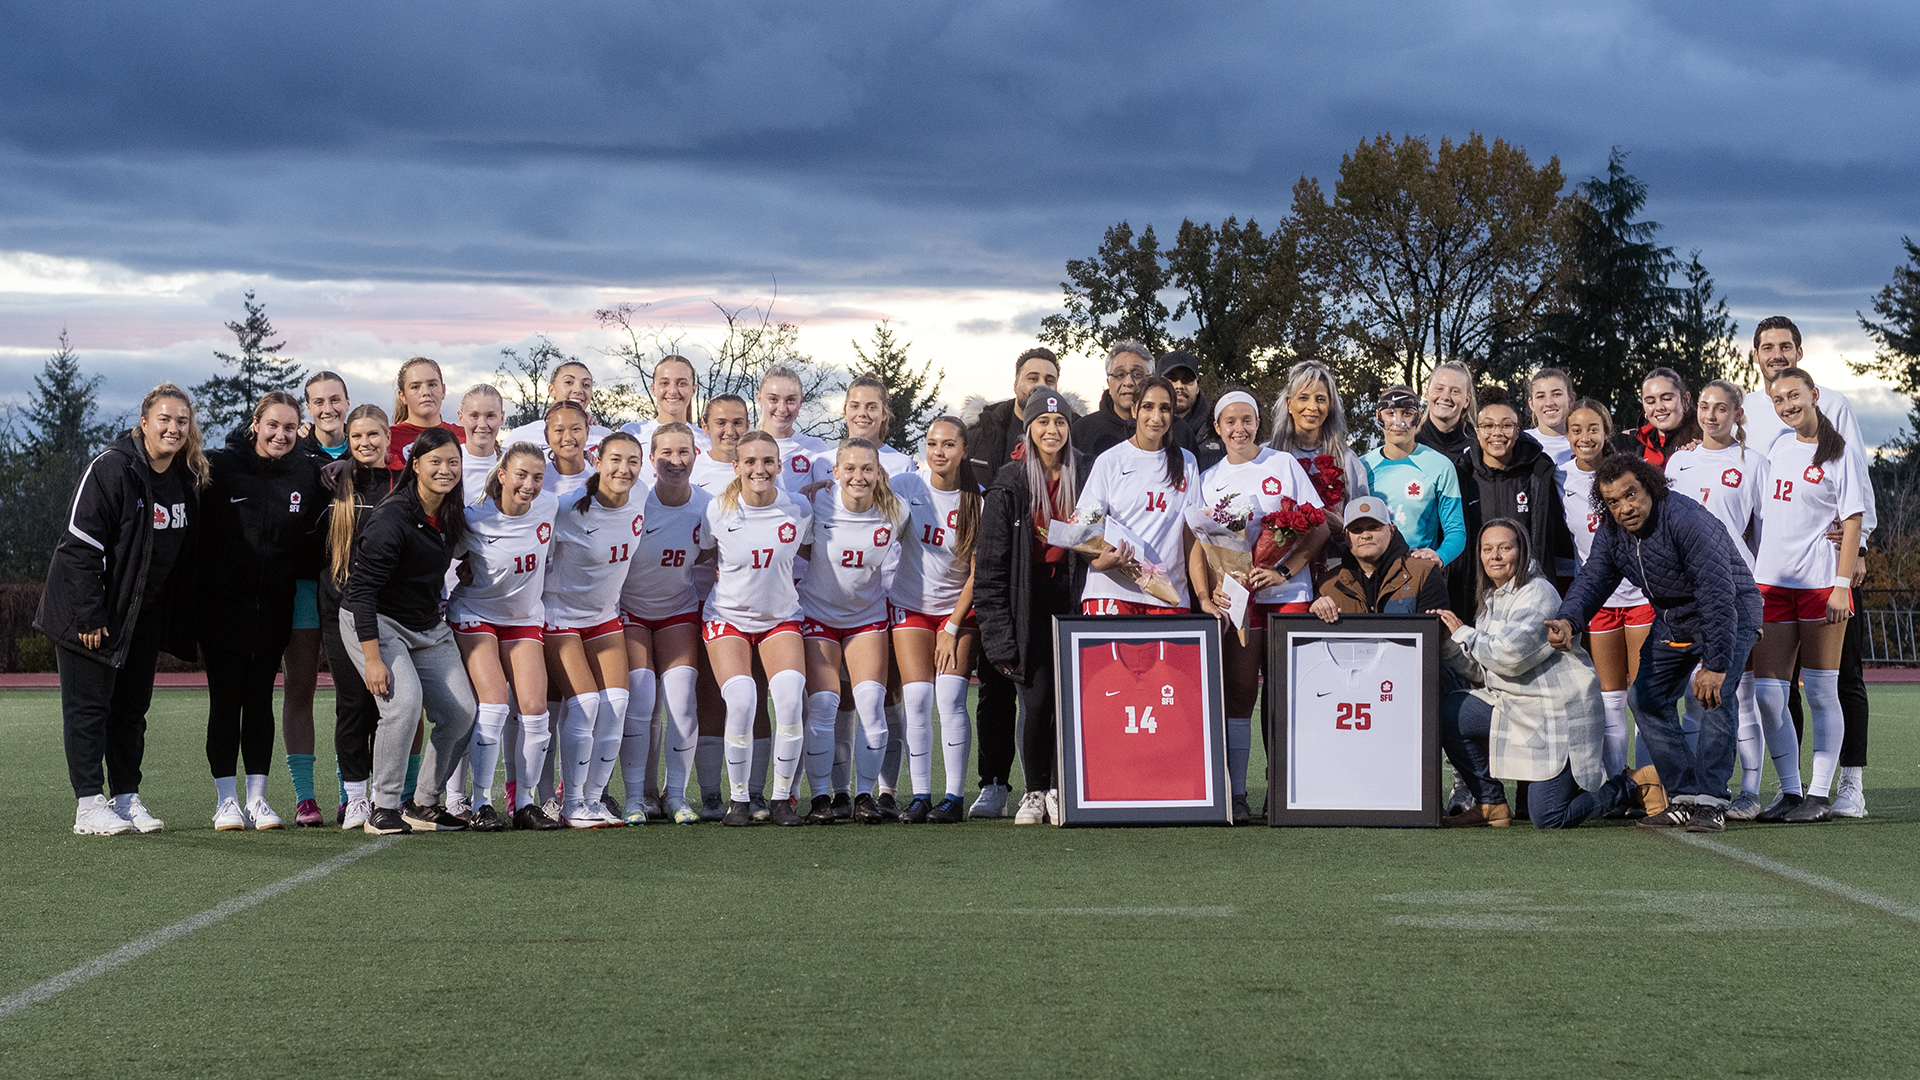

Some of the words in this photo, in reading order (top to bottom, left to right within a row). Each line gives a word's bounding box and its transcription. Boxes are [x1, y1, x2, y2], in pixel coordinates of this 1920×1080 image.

[1700, 487, 1711, 506] 7
[1773, 479, 1793, 502] 12
[1145, 491, 1167, 513] 14
[171, 503, 188, 529] SF
[1587, 513, 1602, 533] 2
[920, 524, 945, 547] 16
[513, 553, 537, 575] 18
[608, 543, 629, 564] 11
[660, 549, 686, 567] 26
[751, 548, 774, 570] 17
[841, 550, 864, 568] 21
[1095, 599, 1119, 615] 14
[706, 619, 726, 640] 17
[1161, 697, 1174, 705] SFU
[1380, 694, 1393, 702] SFU
[1124, 705, 1157, 734] 14
[1336, 702, 1371, 730] 25
